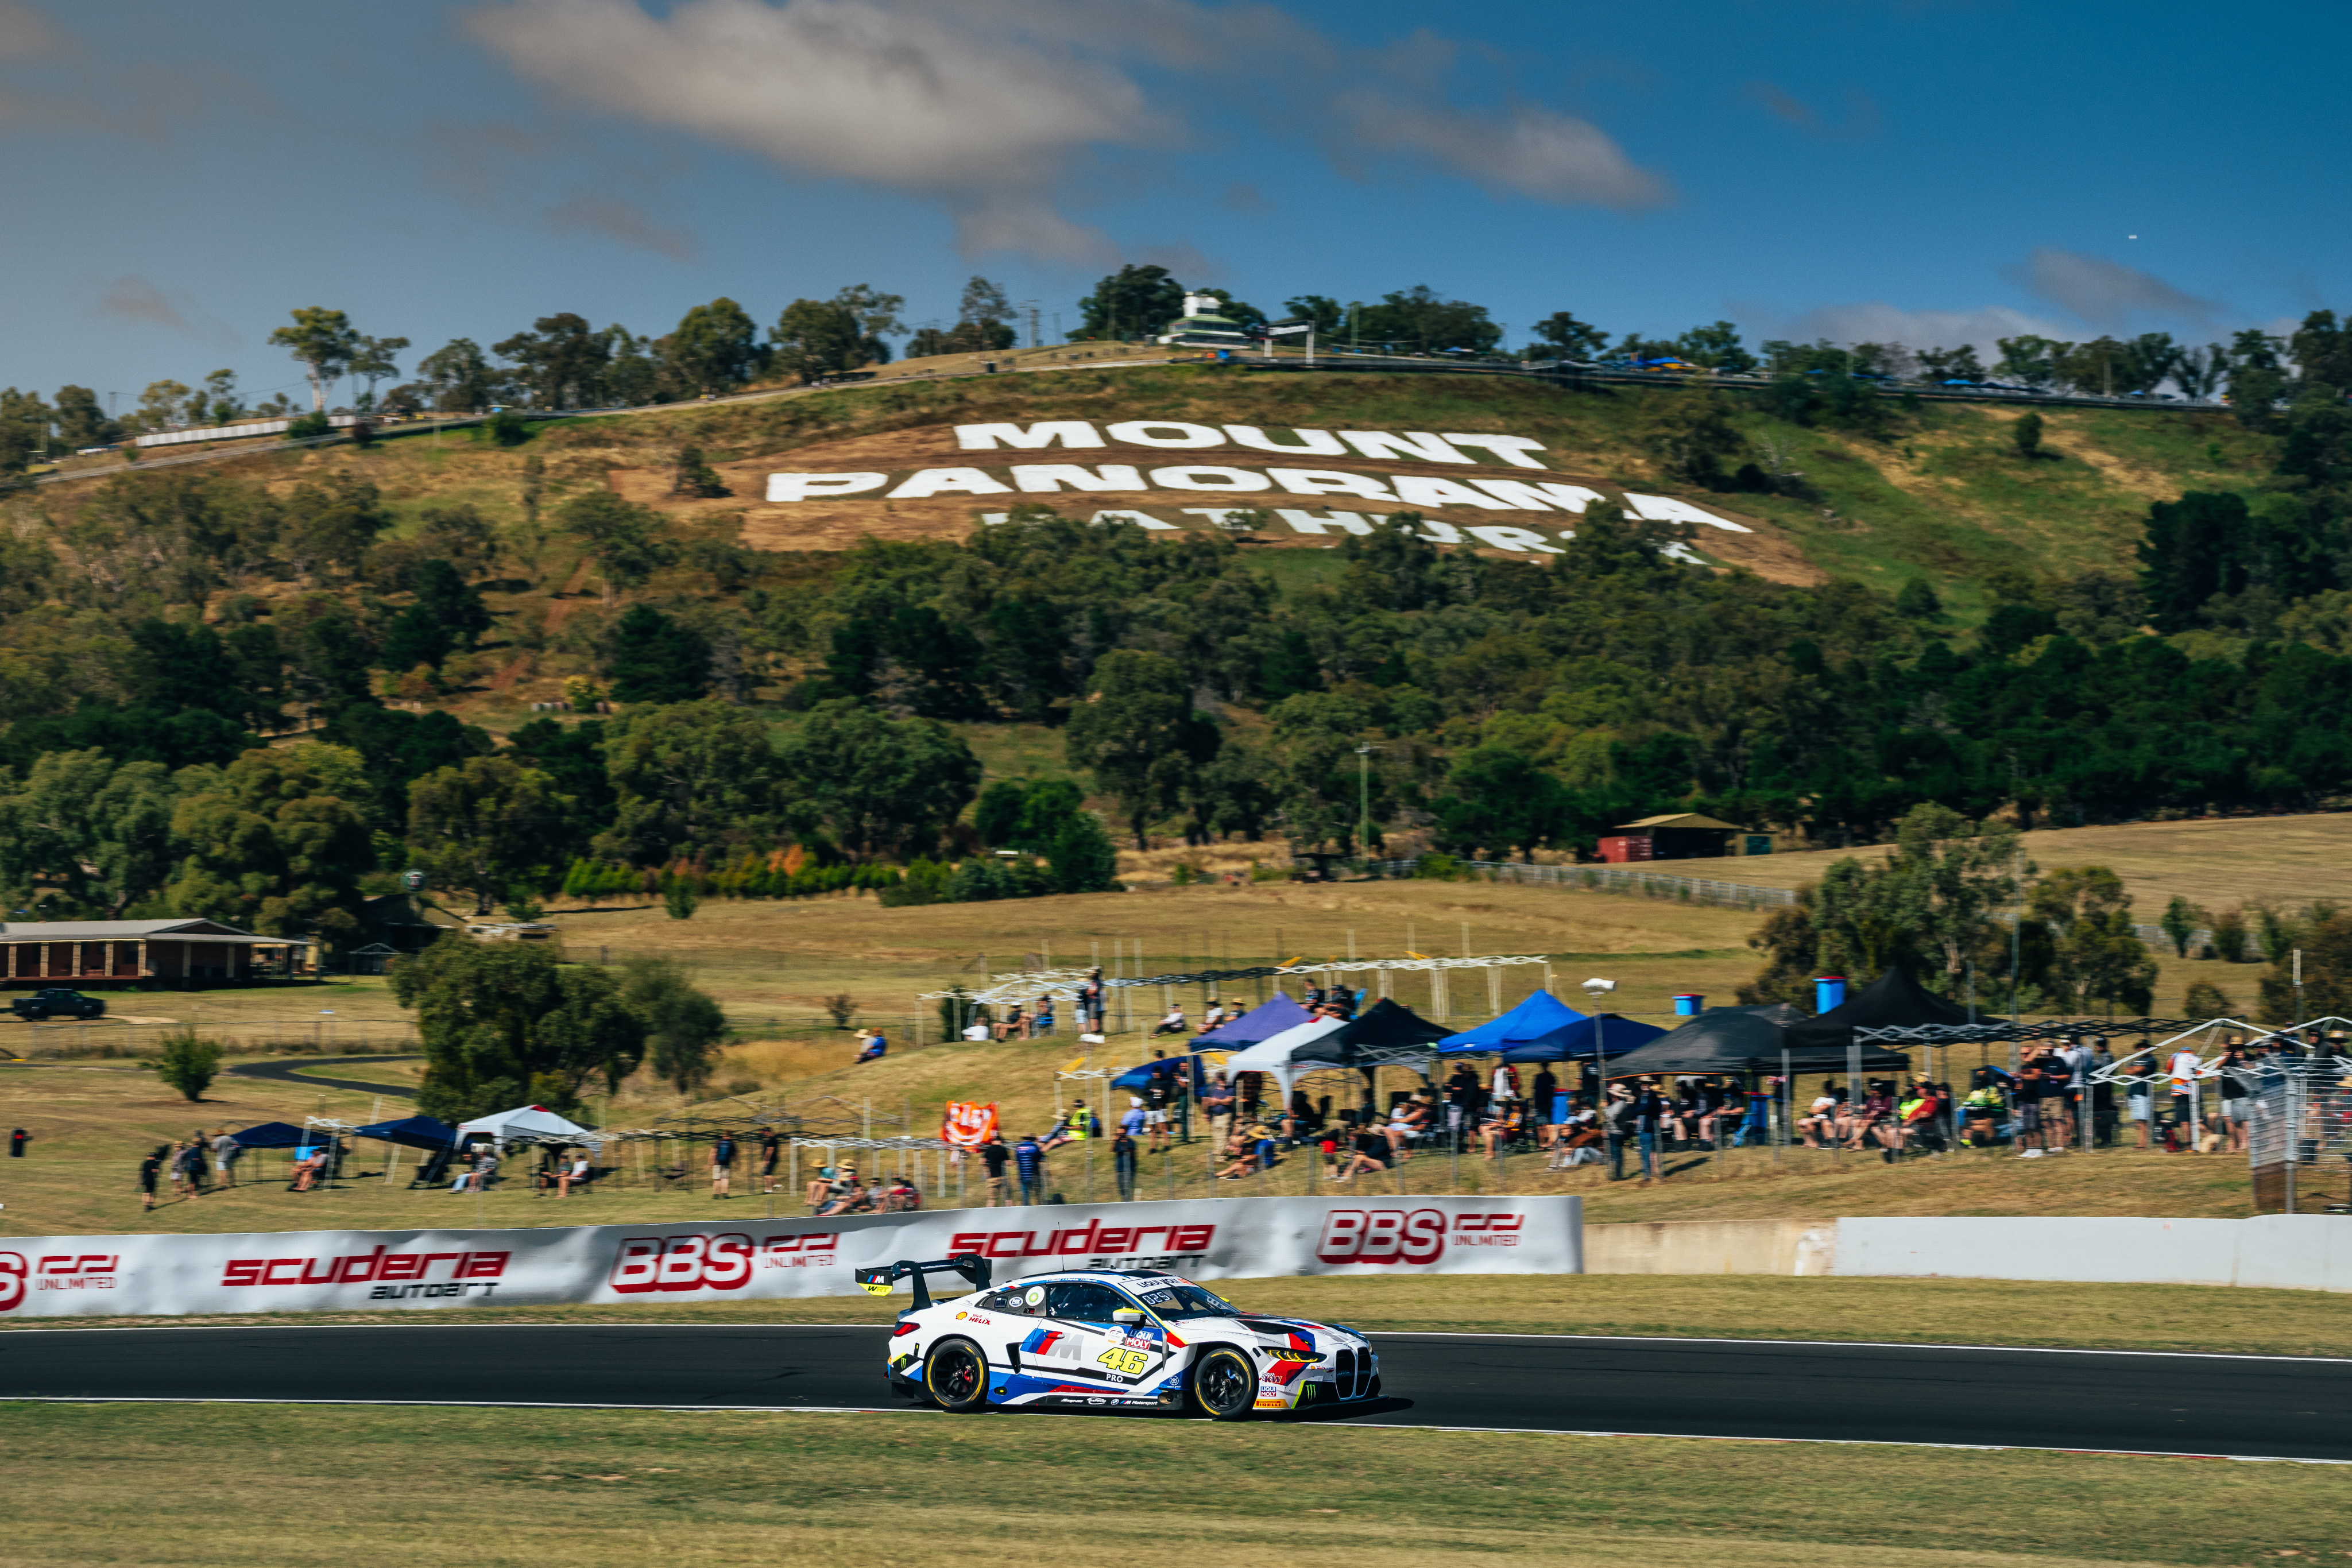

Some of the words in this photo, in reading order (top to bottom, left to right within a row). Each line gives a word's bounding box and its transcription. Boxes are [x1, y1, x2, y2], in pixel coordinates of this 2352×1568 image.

[953, 421, 1549, 469] MOUNT
[766, 464, 1754, 533] PANORAMA
[946, 1218, 1217, 1260] scuderia
[1316, 1209, 1448, 1265] BBS
[1450, 1234, 1521, 1246] UNLIMITED
[220, 1245, 513, 1287] scuderia
[609, 1233, 757, 1294] BBS
[761, 1255, 838, 1268] UNLIMITED
[35, 1277, 118, 1290] UNLIMITED
[1136, 1280, 1162, 1288] LIQUI
[969, 1317, 991, 1325] HELIX
[1129, 1330, 1152, 1341] LIQUI
[1126, 1337, 1151, 1349] MOLY
[1097, 1347, 1148, 1375] 46
[1106, 1373, 1124, 1383] PRO
[1264, 1376, 1283, 1384] KW
